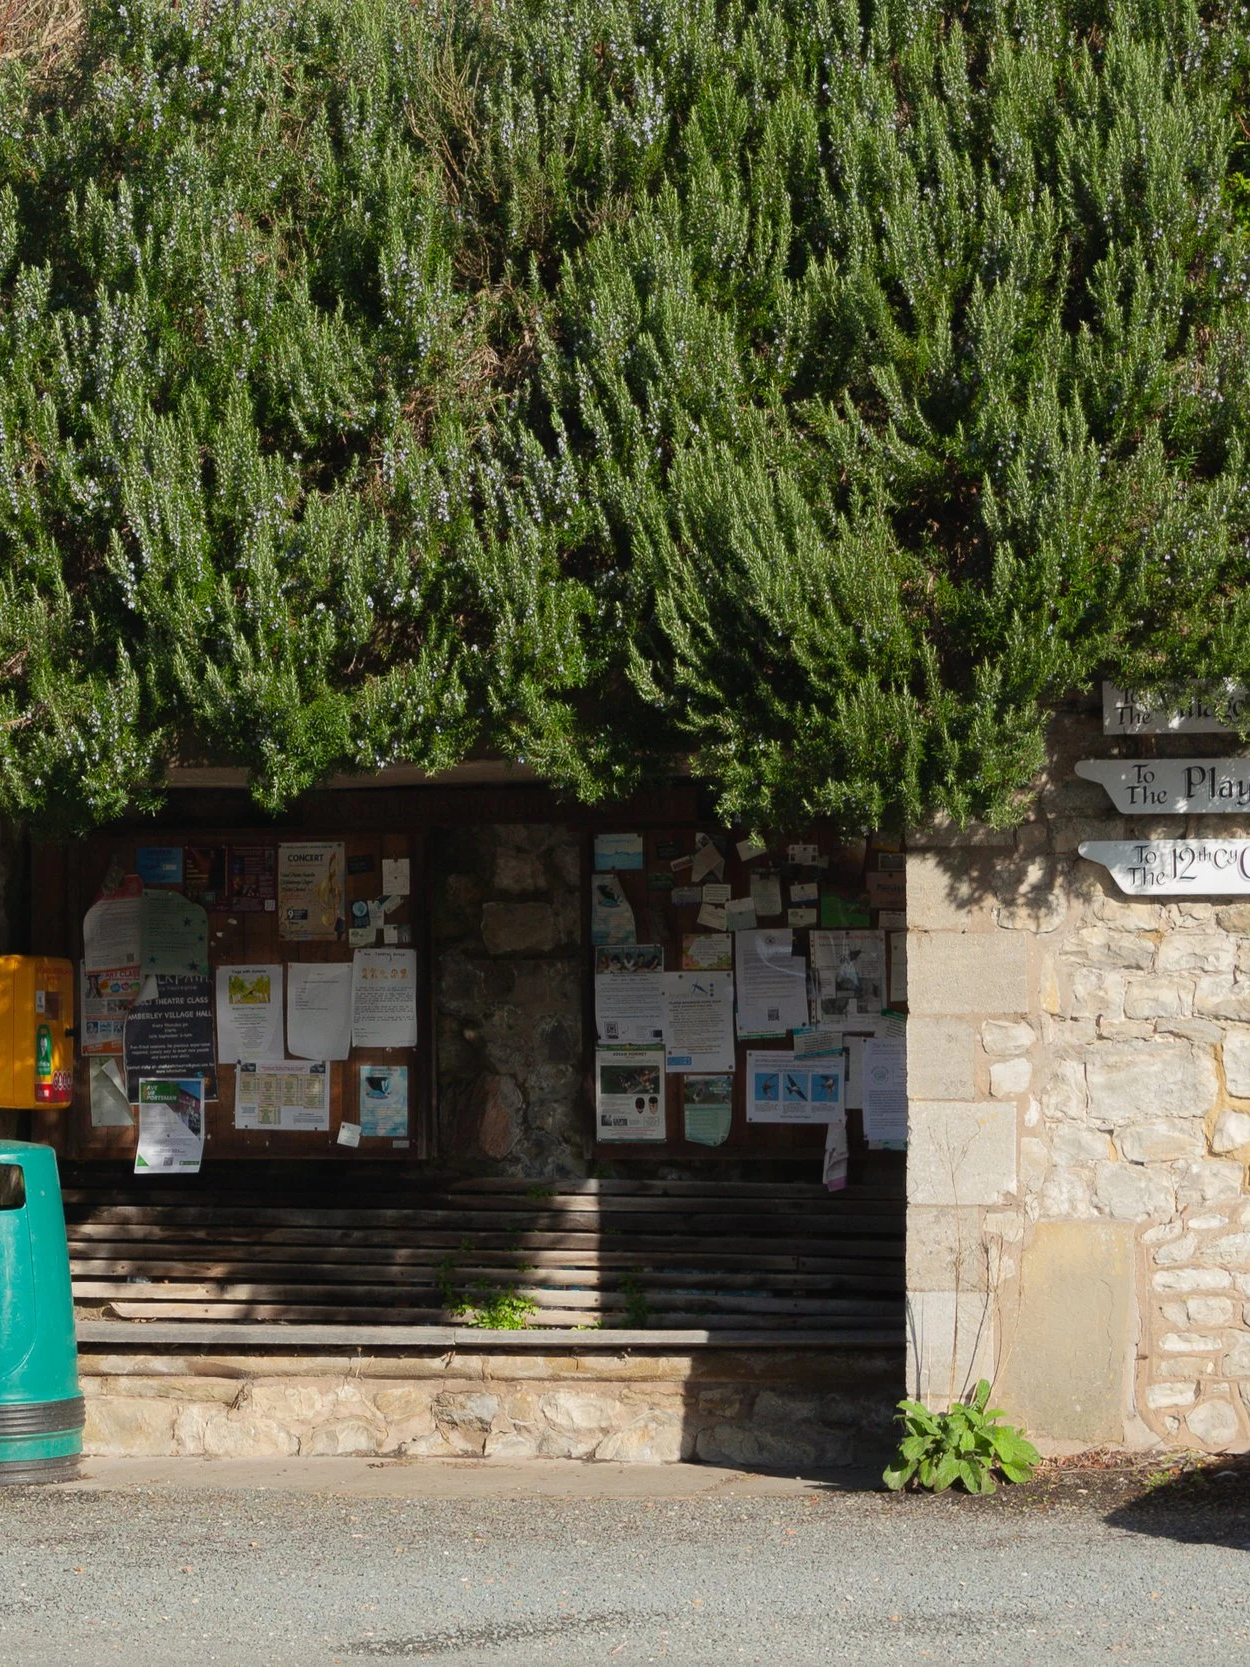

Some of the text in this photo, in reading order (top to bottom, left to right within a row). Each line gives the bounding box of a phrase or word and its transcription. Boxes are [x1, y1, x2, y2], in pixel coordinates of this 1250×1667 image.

[1115, 704, 1152, 724] The
[1131, 764, 1155, 783] To
[1125, 785, 1168, 805] The
[287, 854, 324, 862] CONCERT
[1133, 845, 1157, 864] To
[1127, 867, 1166, 886] The
[155, 997, 184, 1005] THEATRE
[187, 996, 209, 1004] CLASS
[128, 1012, 162, 1020] AMBERLEY
